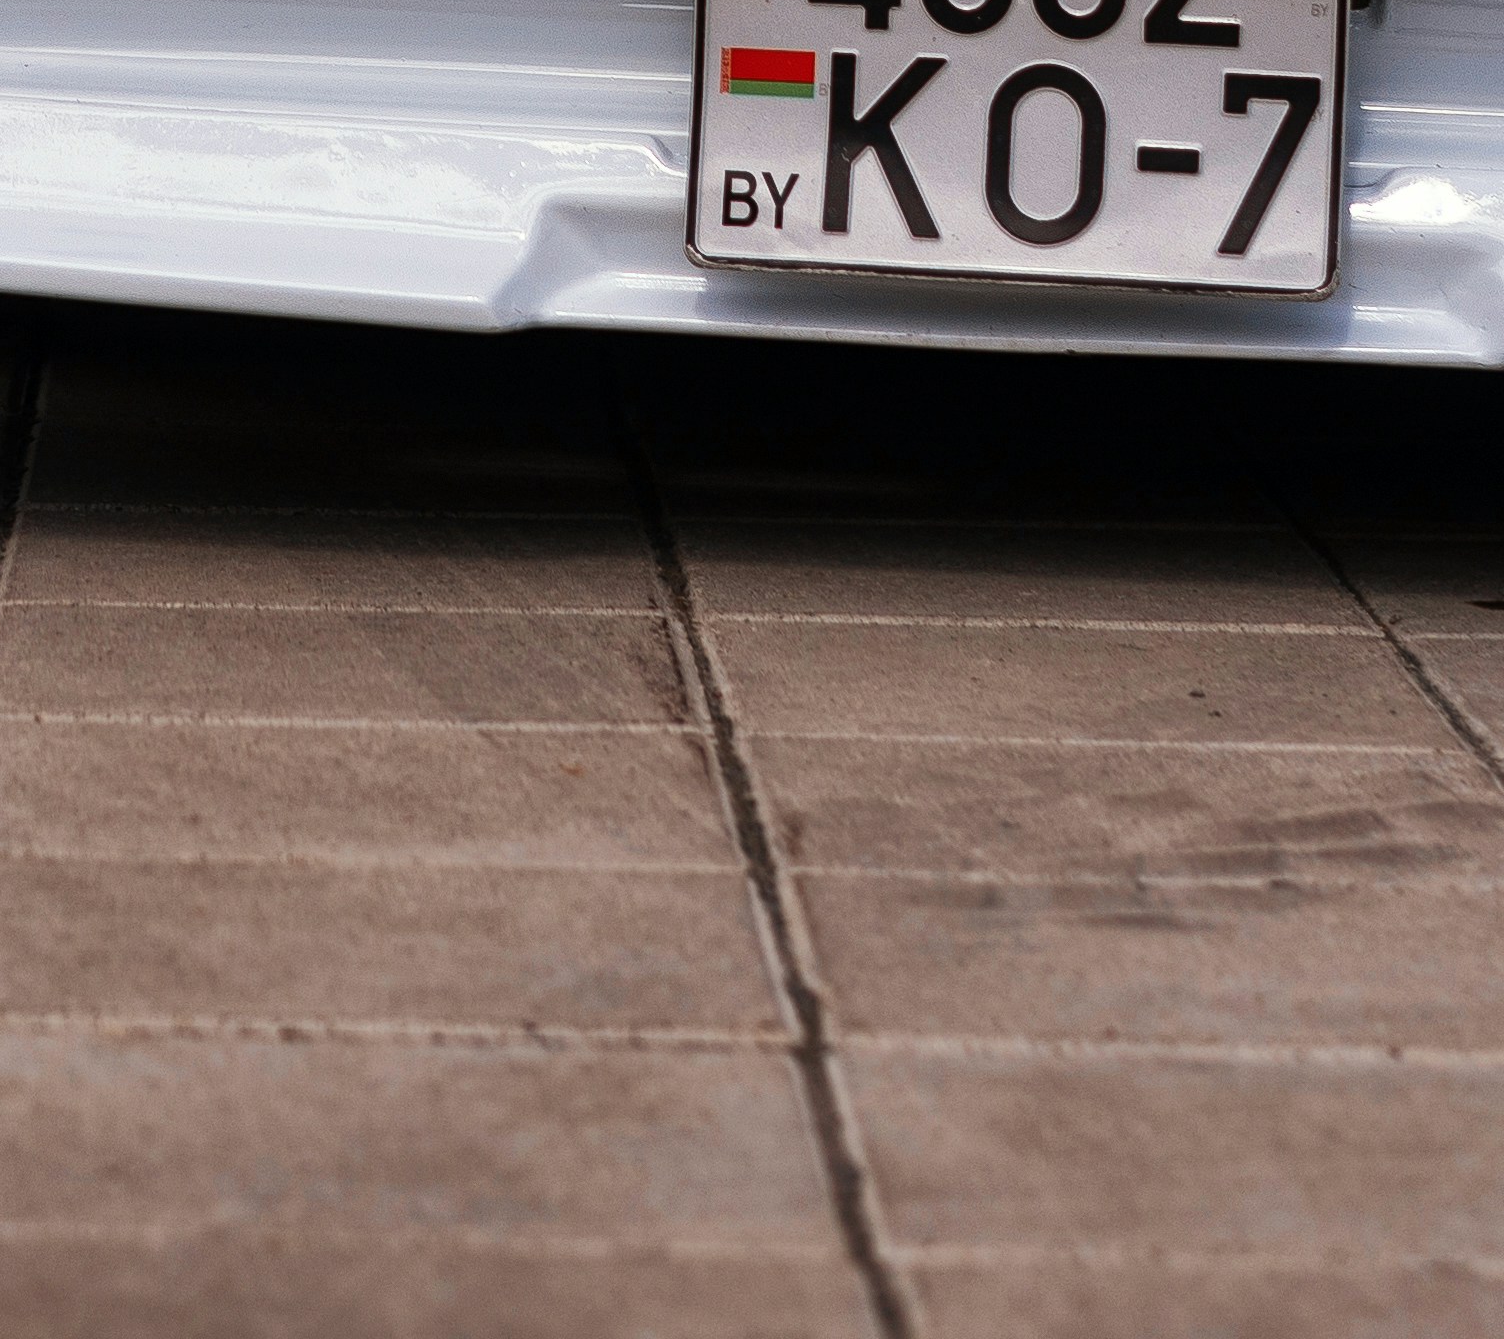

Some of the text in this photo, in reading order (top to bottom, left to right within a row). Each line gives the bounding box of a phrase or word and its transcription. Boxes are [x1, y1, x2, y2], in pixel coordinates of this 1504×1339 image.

[1311, 3, 1328, 17] BY
[821, 51, 1321, 255] KO-7
[722, 170, 799, 229] BY
